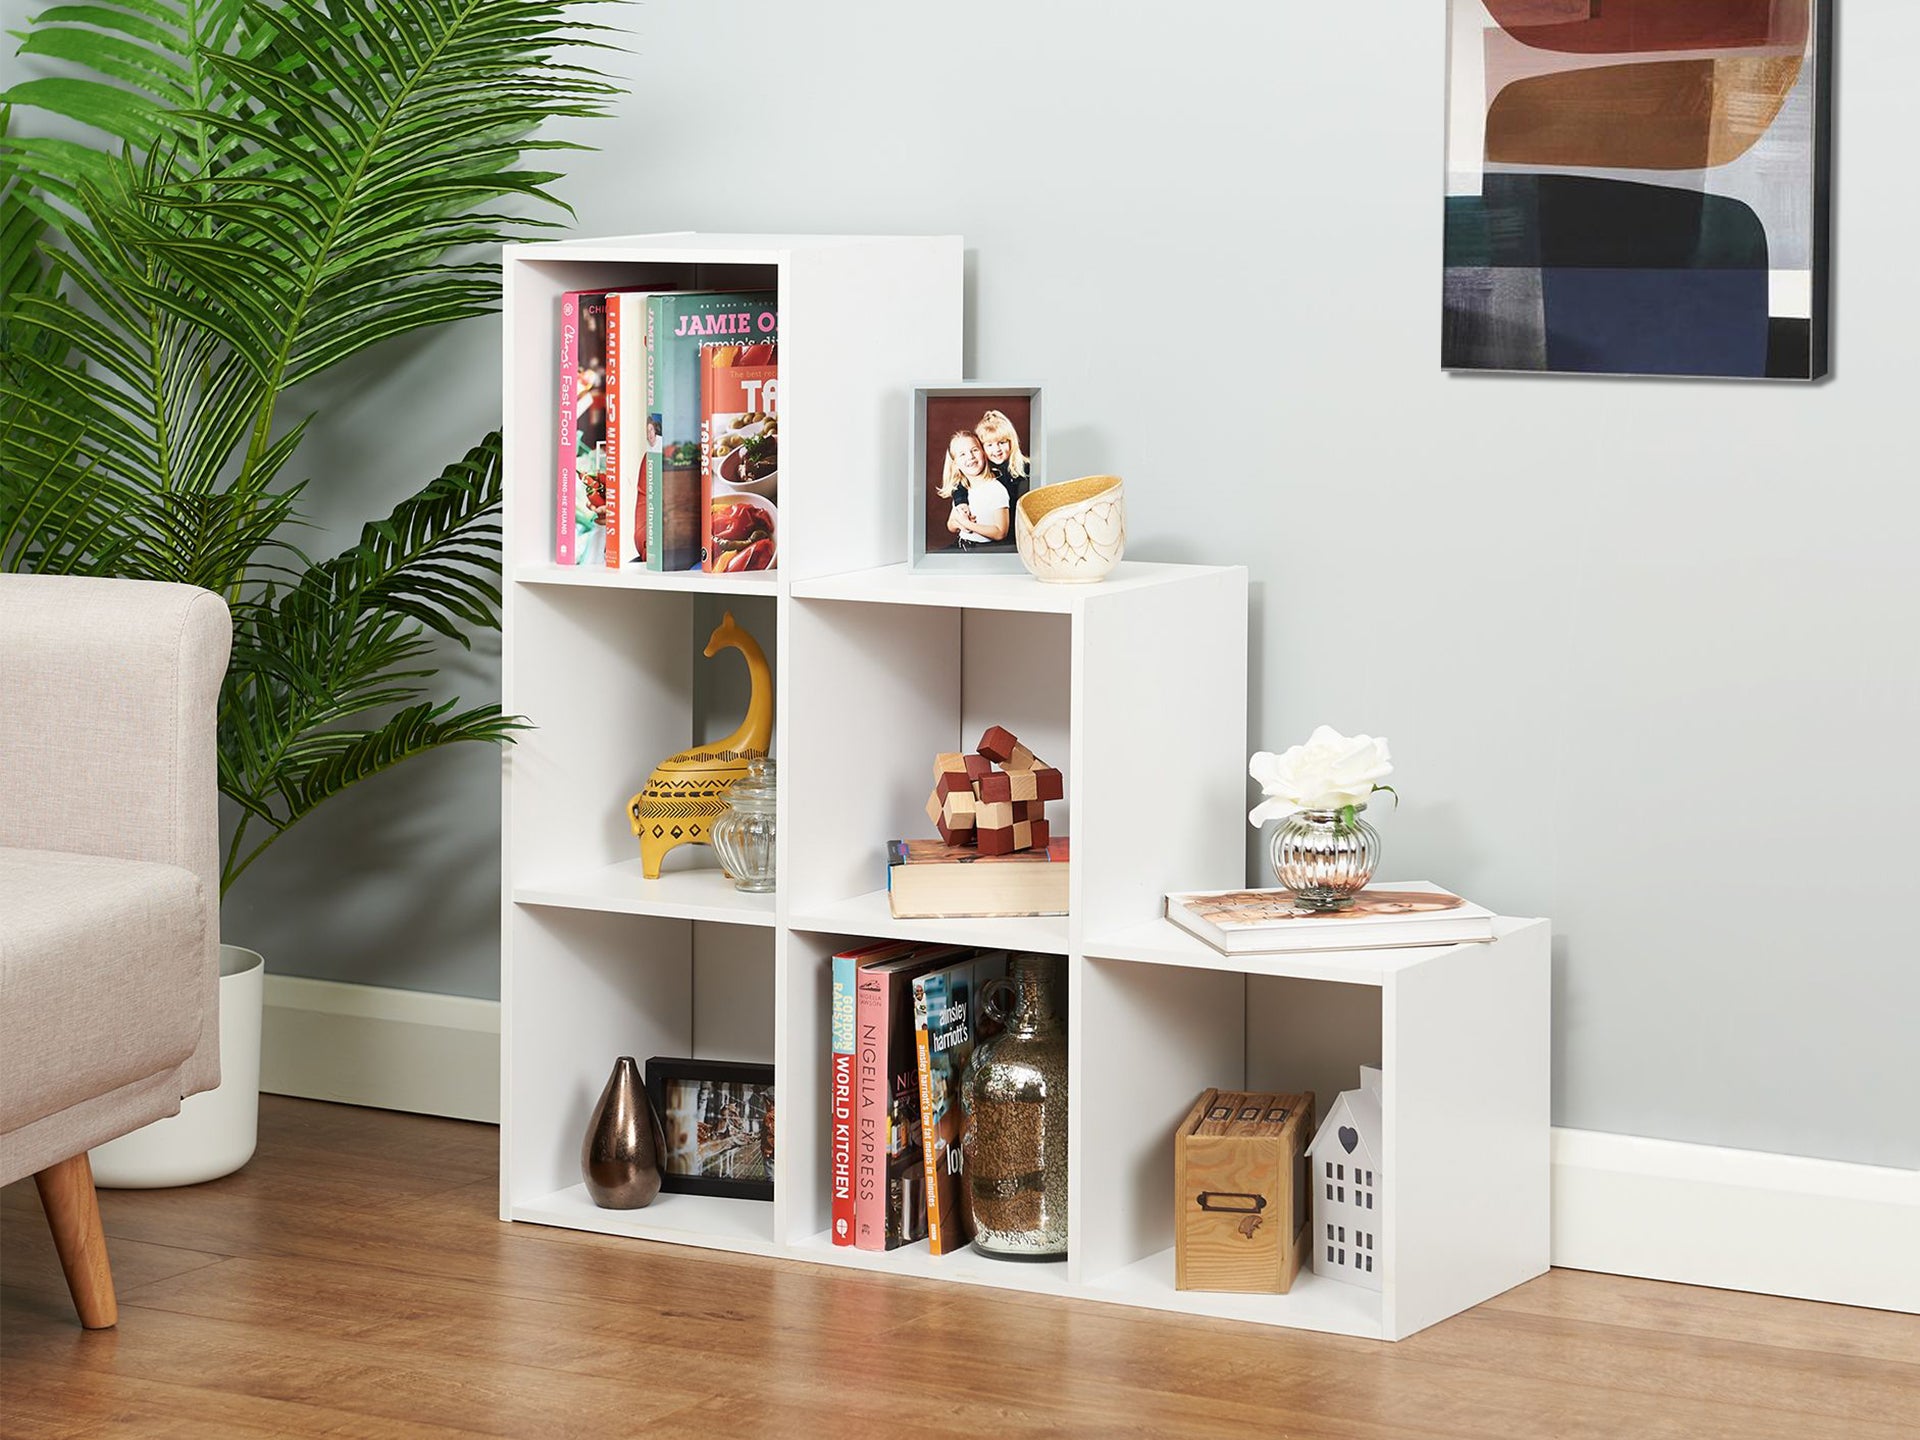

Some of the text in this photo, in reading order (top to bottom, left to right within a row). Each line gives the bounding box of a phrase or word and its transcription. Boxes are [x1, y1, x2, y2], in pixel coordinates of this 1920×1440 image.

[588, 305, 607, 315] CHI
[674, 312, 778, 337] JAMIE O
[647, 307, 655, 406] JAMIE OLIVER
[561, 375, 573, 407] Fast
[561, 410, 572, 447] Food
[700, 420, 709, 476] TAPAS
[606, 427, 616, 482] MINUTE
[560, 507, 569, 535] HUANG
[605, 488, 616, 536] MEALS
[647, 502, 655, 547] dinners
[833, 982, 845, 1050] RAMSAY'S
[842, 995, 854, 1051] GORDON
[933, 1022, 969, 1053] harriott's
[939, 1001, 967, 1027] ainsley
[836, 1056, 850, 1199] WORLD KITCHEN
[860, 1025, 877, 1201] NIGELLA EXPRESS
[918, 1044, 936, 1208] ainsley harriott's low fat meals in minutes
